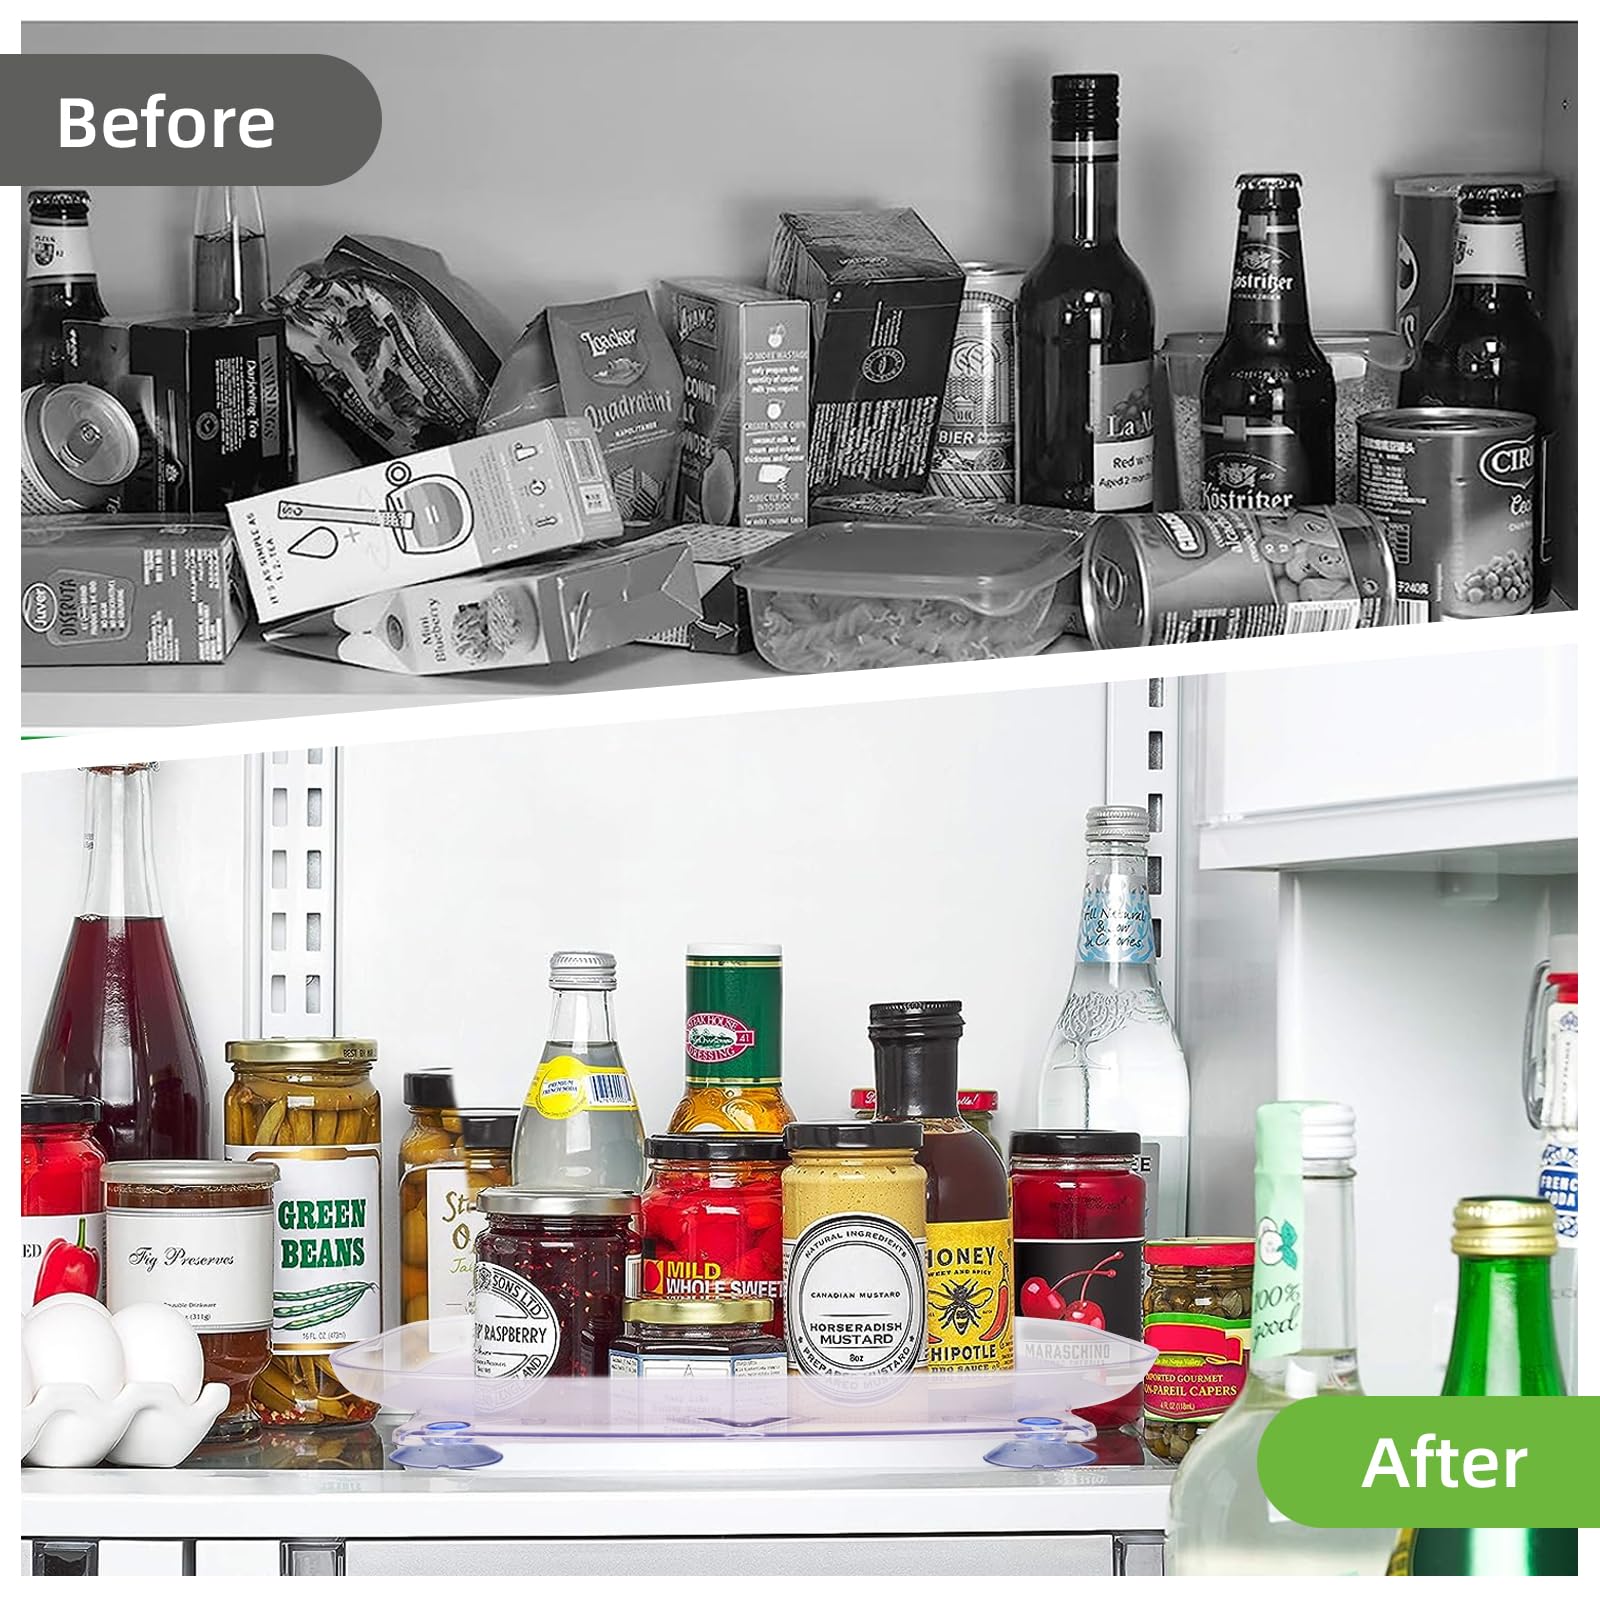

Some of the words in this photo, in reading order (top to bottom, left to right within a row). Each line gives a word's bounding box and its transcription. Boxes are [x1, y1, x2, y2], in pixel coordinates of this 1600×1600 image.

[261, 354, 278, 442] TWININGS
[584, 390, 673, 433] Quadratini
[248, 418, 260, 439] Tea
[1106, 415, 1136, 438] La
[938, 430, 974, 446] BIER
[1112, 454, 1135, 469] Red
[34, 588, 48, 627] Juver
[59, 578, 77, 637] DISFRUTA
[428, 598, 447, 663] Blueberry
[278, 1199, 366, 1230] GREEN
[281, 1237, 366, 1269] BEANS
[804, 1231, 844, 1259] NATURAL
[846, 1230, 907, 1258] INGREDIENTS
[128, 1246, 159, 1273] Fig
[163, 1246, 234, 1266] Preserves
[667, 1260, 721, 1280] MILD
[492, 1275, 521, 1298] SONS
[520, 1292, 542, 1316] LTD
[666, 1278, 726, 1295] WHOLE
[730, 1280, 786, 1298] SWEET
[810, 1291, 856, 1299] CANADIAN
[859, 1291, 901, 1299] MUSTARD
[189, 1313, 212, 1322] (311g)
[810, 1322, 902, 1332] HORSERADISH
[484, 1325, 547, 1344] RASPBERRY
[820, 1334, 894, 1345] MUSTARD
[1025, 1342, 1111, 1360] MARASCHINO
[956, 1363, 989, 1372] SAUCE
[1177, 1374, 1223, 1383] GOURMET
[1189, 1385, 1238, 1396] CAPERS
